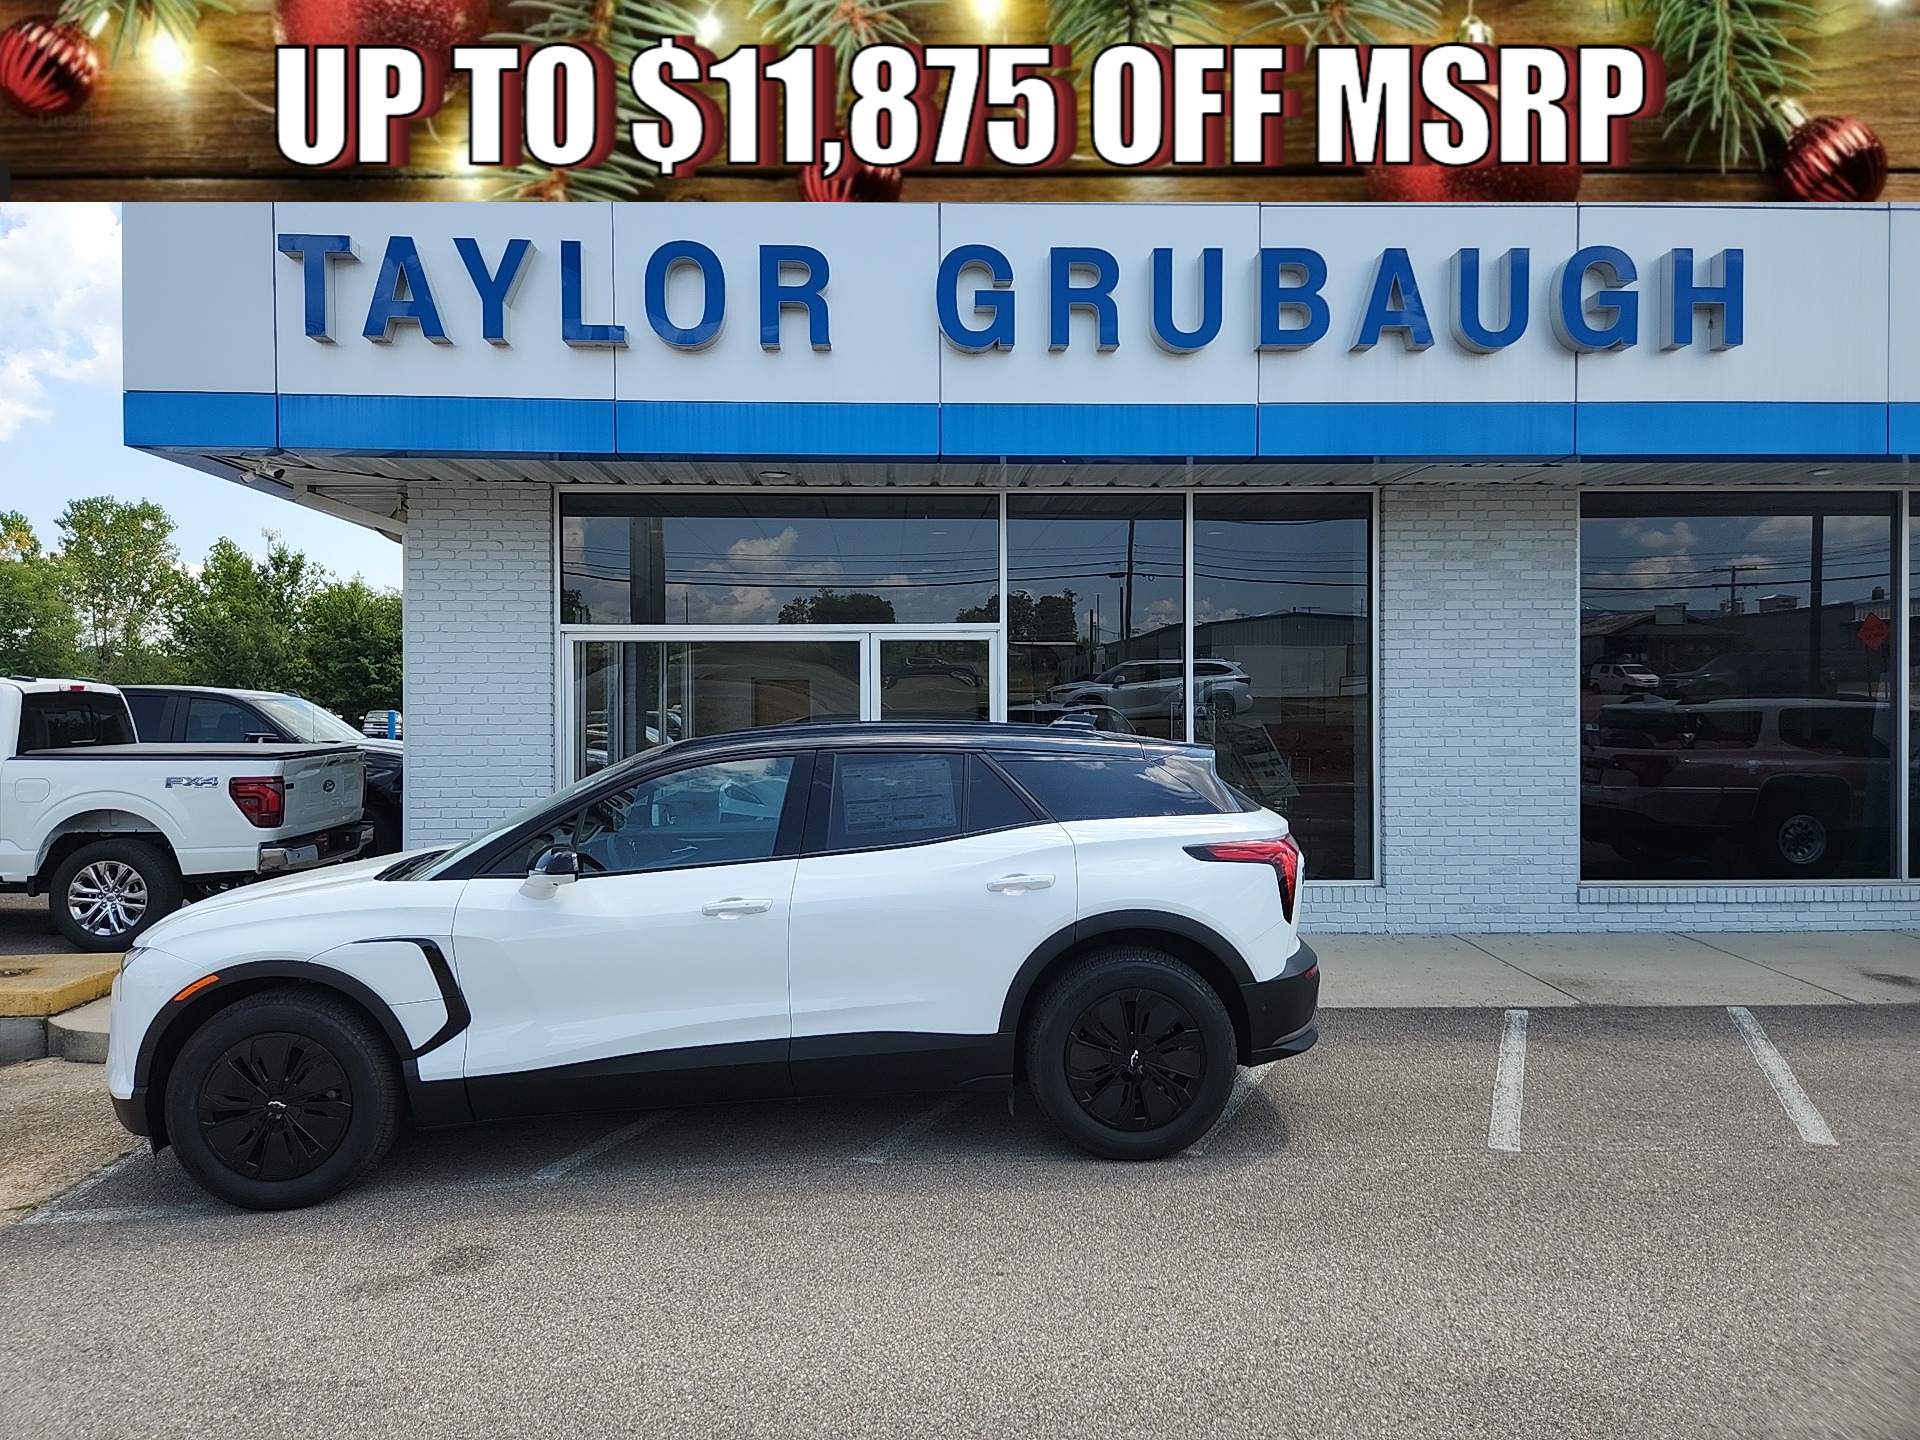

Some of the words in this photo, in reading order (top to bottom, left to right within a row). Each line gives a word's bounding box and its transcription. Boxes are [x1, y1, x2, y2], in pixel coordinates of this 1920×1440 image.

[277, 234, 832, 352] TAYLOR
[937, 244, 1744, 354] GRUBAUGH
[165, 776, 219, 789] FX4
